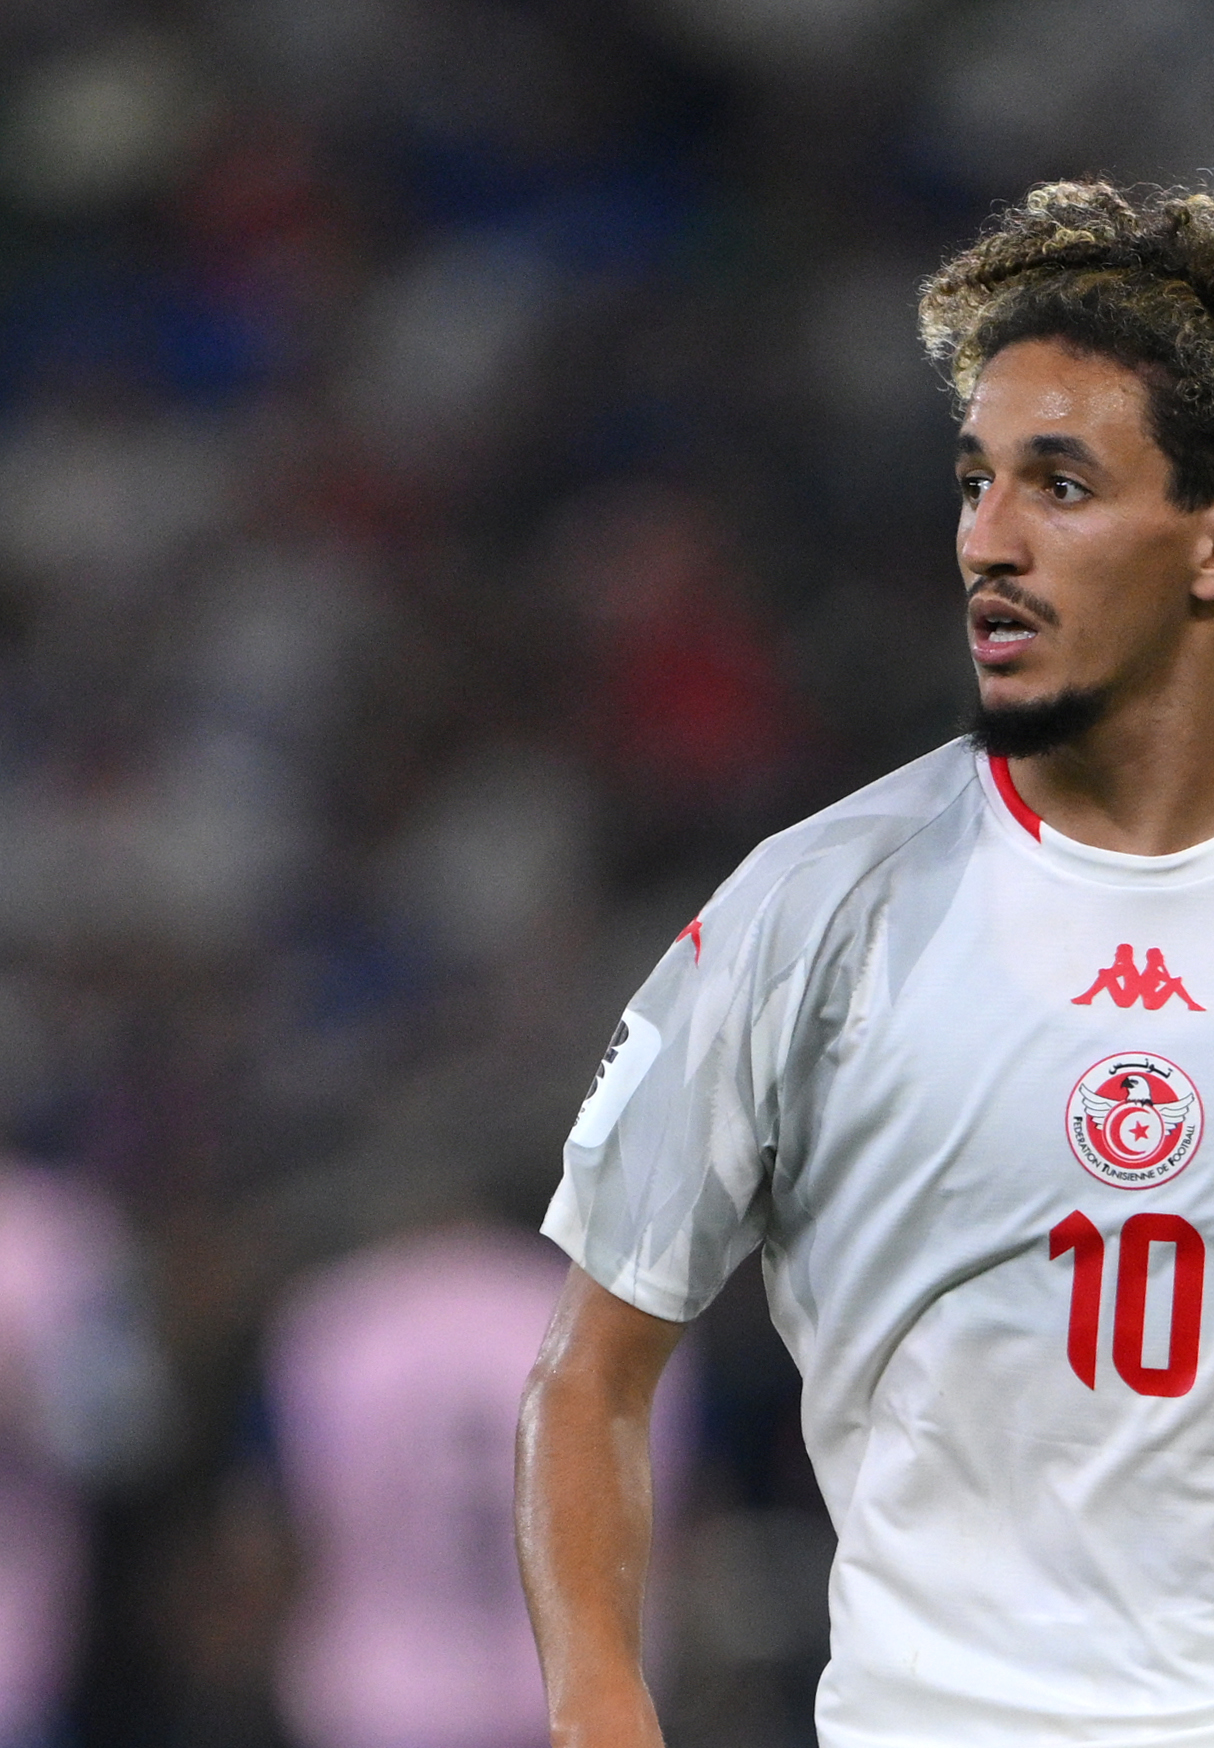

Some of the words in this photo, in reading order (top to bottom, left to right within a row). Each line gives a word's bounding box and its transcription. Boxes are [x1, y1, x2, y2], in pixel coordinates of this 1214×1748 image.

[1073, 1115, 1102, 1168] FEDERATION
[1101, 1163, 1156, 1182] TUNISIENNE
[1157, 1164, 1169, 1176] DE
[1169, 1124, 1196, 1167] FOOTBALL
[1049, 1209, 1206, 1398] 10
